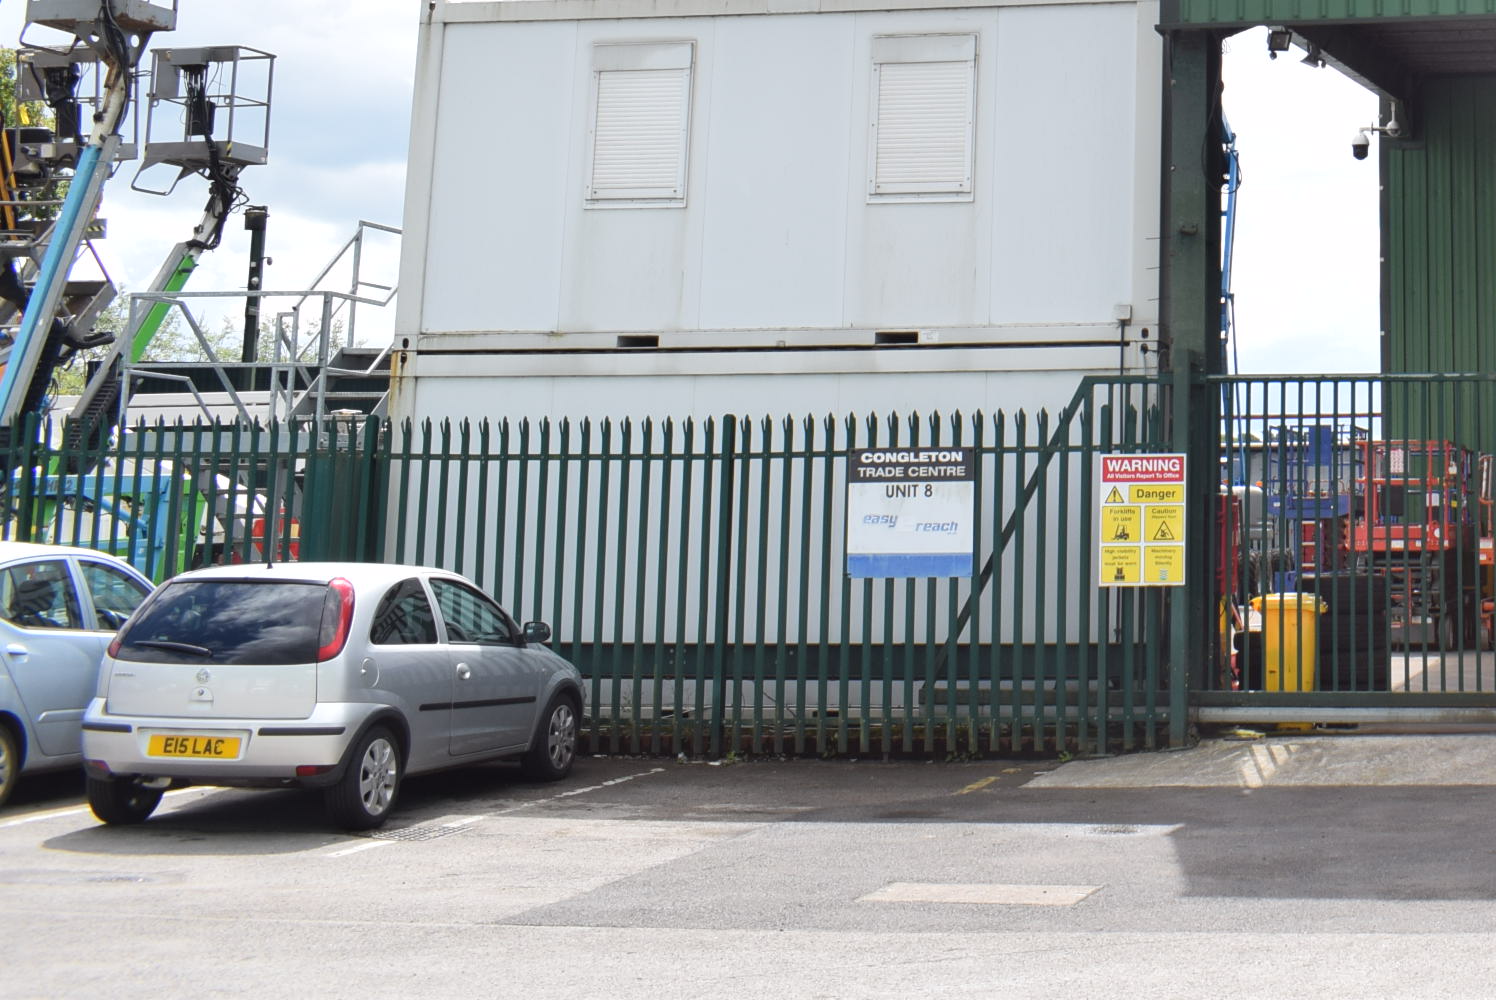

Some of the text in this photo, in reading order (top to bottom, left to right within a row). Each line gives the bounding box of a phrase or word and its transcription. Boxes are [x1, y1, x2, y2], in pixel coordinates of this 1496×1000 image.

[861, 451, 963, 463] CONGLETON
[857, 466, 966, 477] TRADE CENTRE
[1107, 459, 1180, 472] WARNING
[886, 484, 933, 498] UNIT 8
[1136, 489, 1176, 500] Danger
[863, 514, 958, 532] easy reach
[163, 737, 225, 755] E15 LAC
